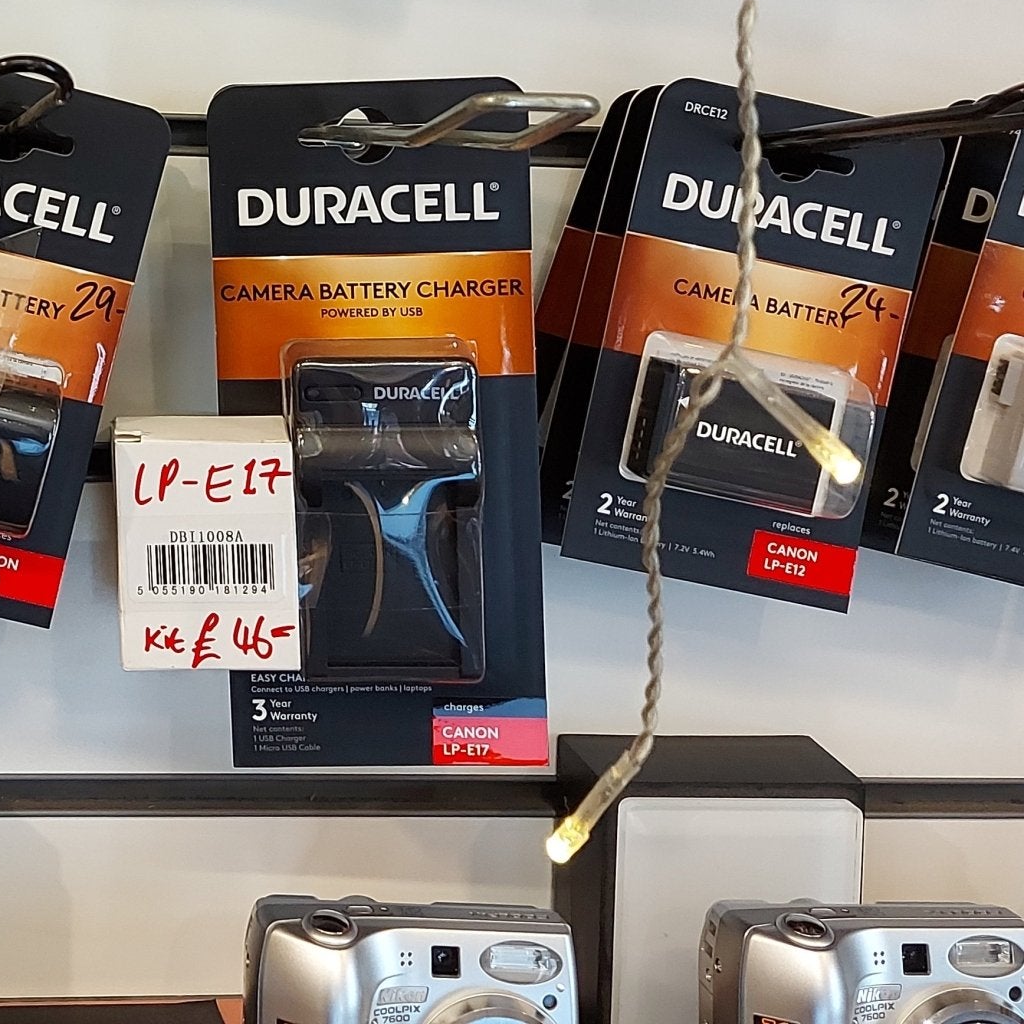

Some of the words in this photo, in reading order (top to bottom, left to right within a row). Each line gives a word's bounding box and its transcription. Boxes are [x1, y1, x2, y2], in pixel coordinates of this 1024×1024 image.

[684, 101, 729, 120] DRCE12
[237, 182, 500, 227] DURACELL
[220, 283, 314, 302] CAMERA
[319, 281, 412, 300] BATTERY
[416, 278, 525, 298] CHARGER
[321, 307, 379, 319] POWERED
[382, 307, 397, 318] BY
[400, 306, 424, 317] USB
[765, 298, 851, 330] BATTERY
[696, 420, 798, 458] DURACELL
[617, 495, 637, 507] Year
[953, 497, 972, 508] Year
[950, 508, 991, 526] Warranty
[772, 520, 811, 536] replaces
[170, 530, 244, 543] DBI1008A
[767, 541, 819, 563] CANON
[763, 558, 807, 578] LP-E12
[251, 674, 276, 682] EASY
[312, 685, 344, 693] chargers
[252, 699, 267, 721] 3
[270, 699, 291, 708] Year
[444, 702, 484, 713] charges
[270, 712, 317, 722] Warranty
[442, 726, 499, 739] CANON
[442, 742, 490, 756] LP-E17
[373, 1005, 421, 1017] COOLPIX
[854, 1003, 895, 1014] COOLPIX
